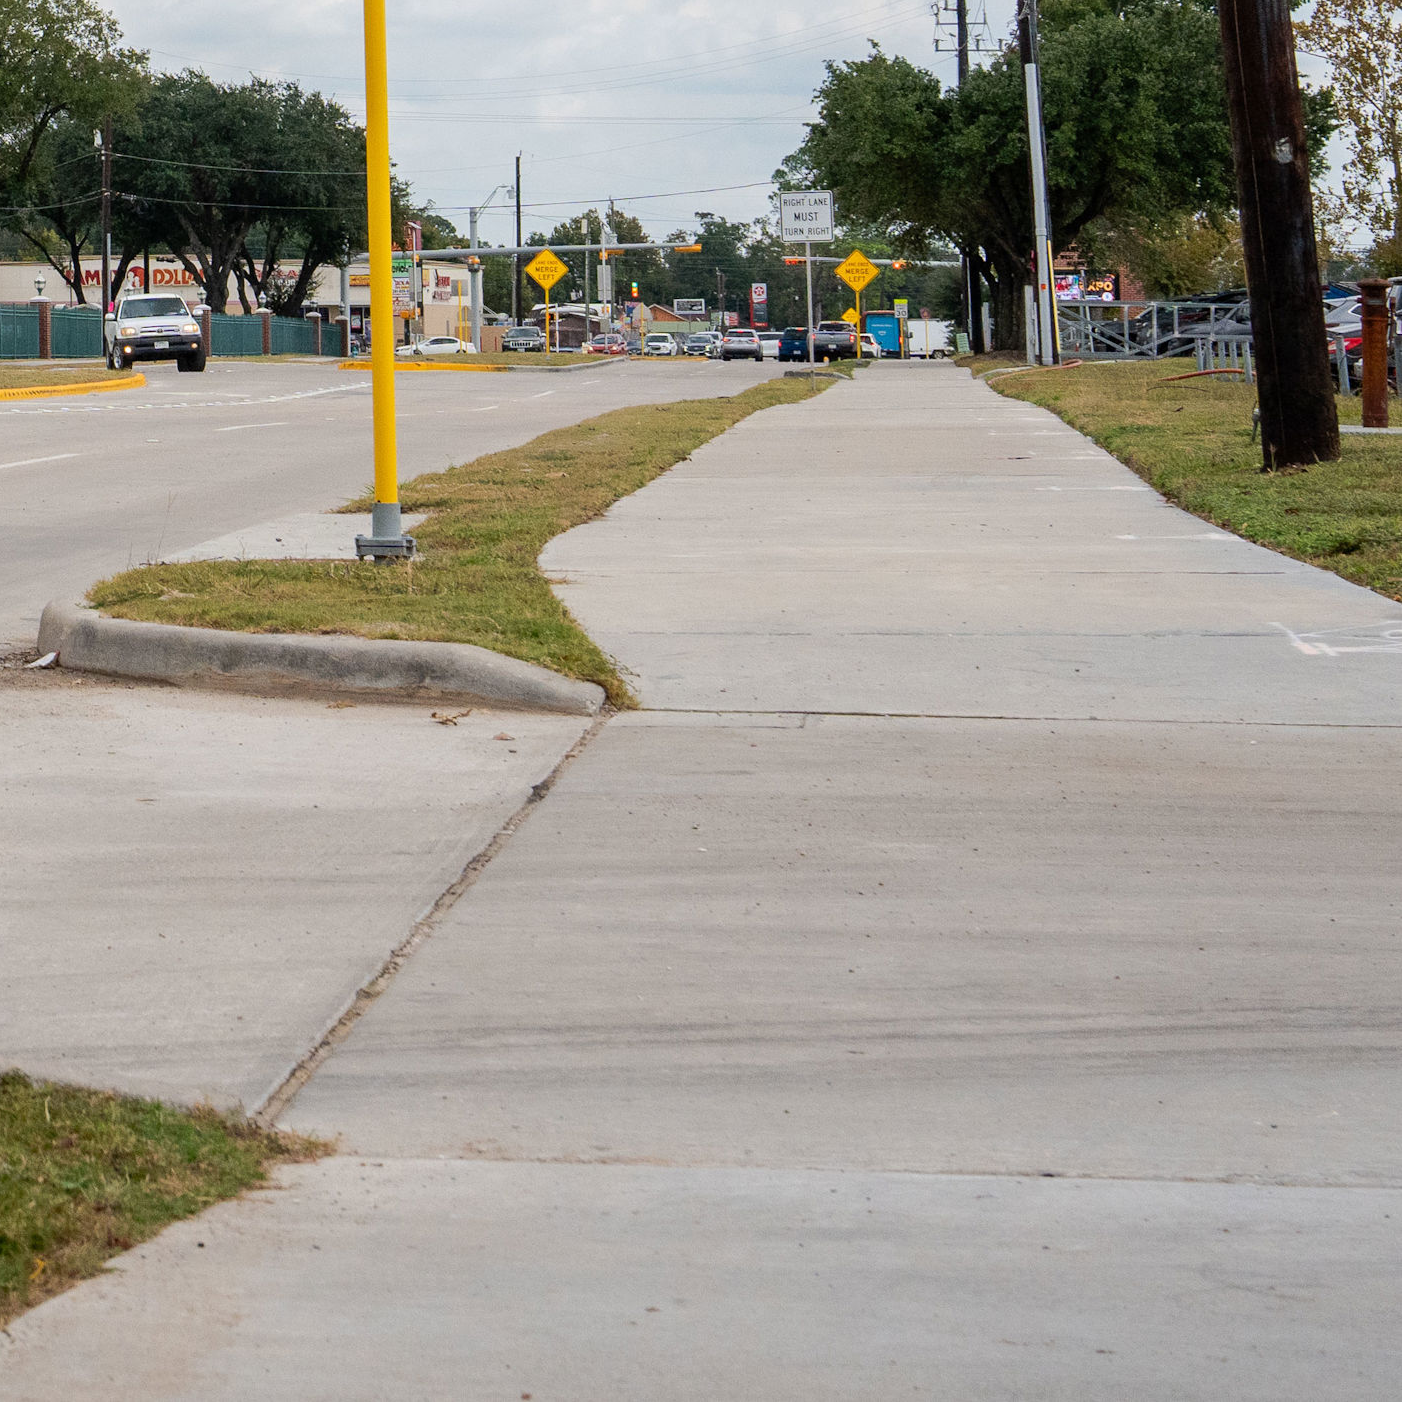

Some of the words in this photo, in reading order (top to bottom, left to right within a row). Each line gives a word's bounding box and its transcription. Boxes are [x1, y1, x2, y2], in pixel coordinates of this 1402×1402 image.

[783, 198, 805, 207] RIGHT
[808, 198, 828, 206] LANE
[793, 212, 819, 222] MUST
[784, 228, 804, 236] TURN
[808, 227, 830, 235] RIGHT
